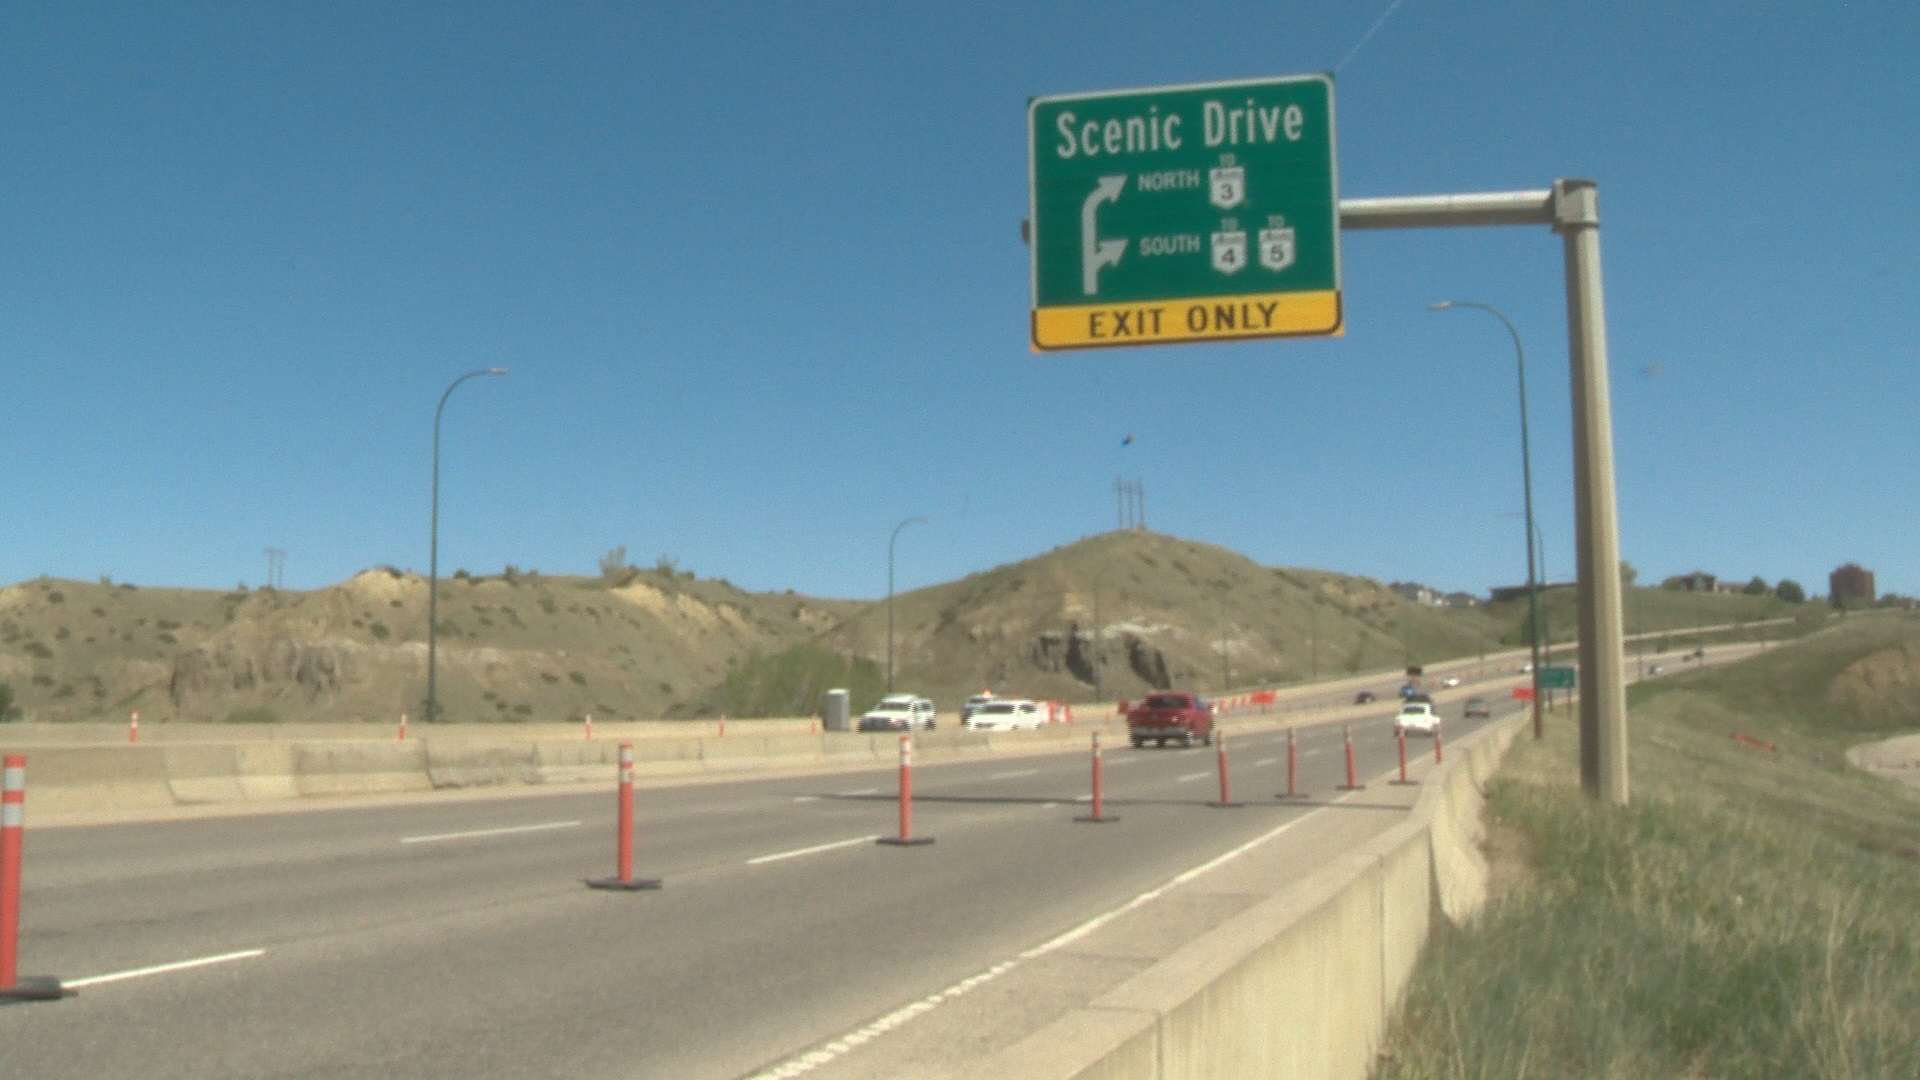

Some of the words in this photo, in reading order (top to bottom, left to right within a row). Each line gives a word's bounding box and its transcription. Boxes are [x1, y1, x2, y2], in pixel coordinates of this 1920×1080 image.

[1056, 106, 1182, 159] Scenic
[1203, 99, 1304, 147] Drive
[1138, 169, 1200, 192] NORTH
[1220, 183, 1234, 201] 3
[1140, 233, 1201, 256] SOUTH
[1221, 247, 1235, 264] 4
[1269, 244, 1284, 262] 5
[1089, 307, 1165, 338] EXIT
[1187, 301, 1279, 334] ONLY
